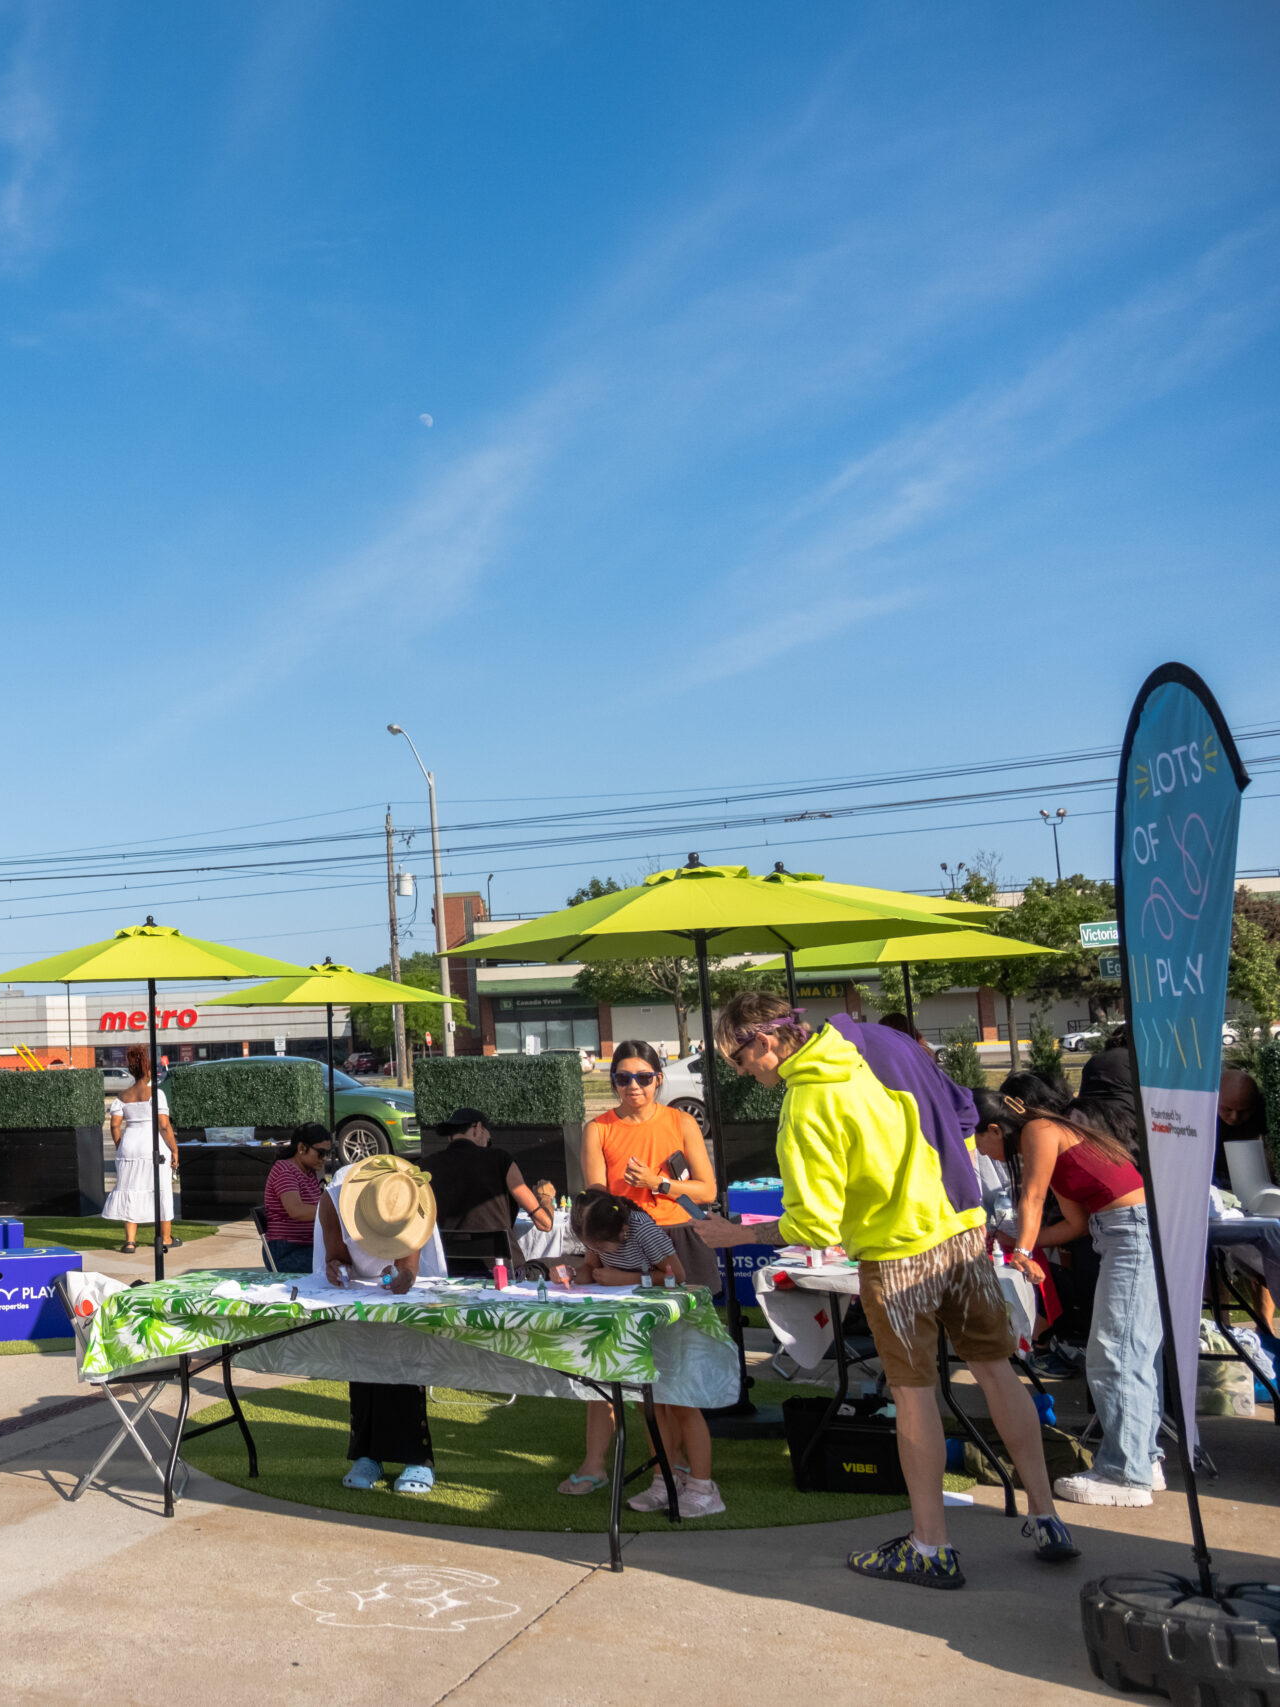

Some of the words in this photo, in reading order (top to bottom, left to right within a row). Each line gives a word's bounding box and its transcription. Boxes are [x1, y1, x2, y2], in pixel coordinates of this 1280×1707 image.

[1148, 741, 1202, 797] LOTS
[1133, 822, 1160, 865] OF
[1082, 926, 1119, 942] Victoria
[543, 998, 562, 1006] Trust
[717, 1256, 754, 1268] LTS
[22, 1286, 56, 1299] PLAY
